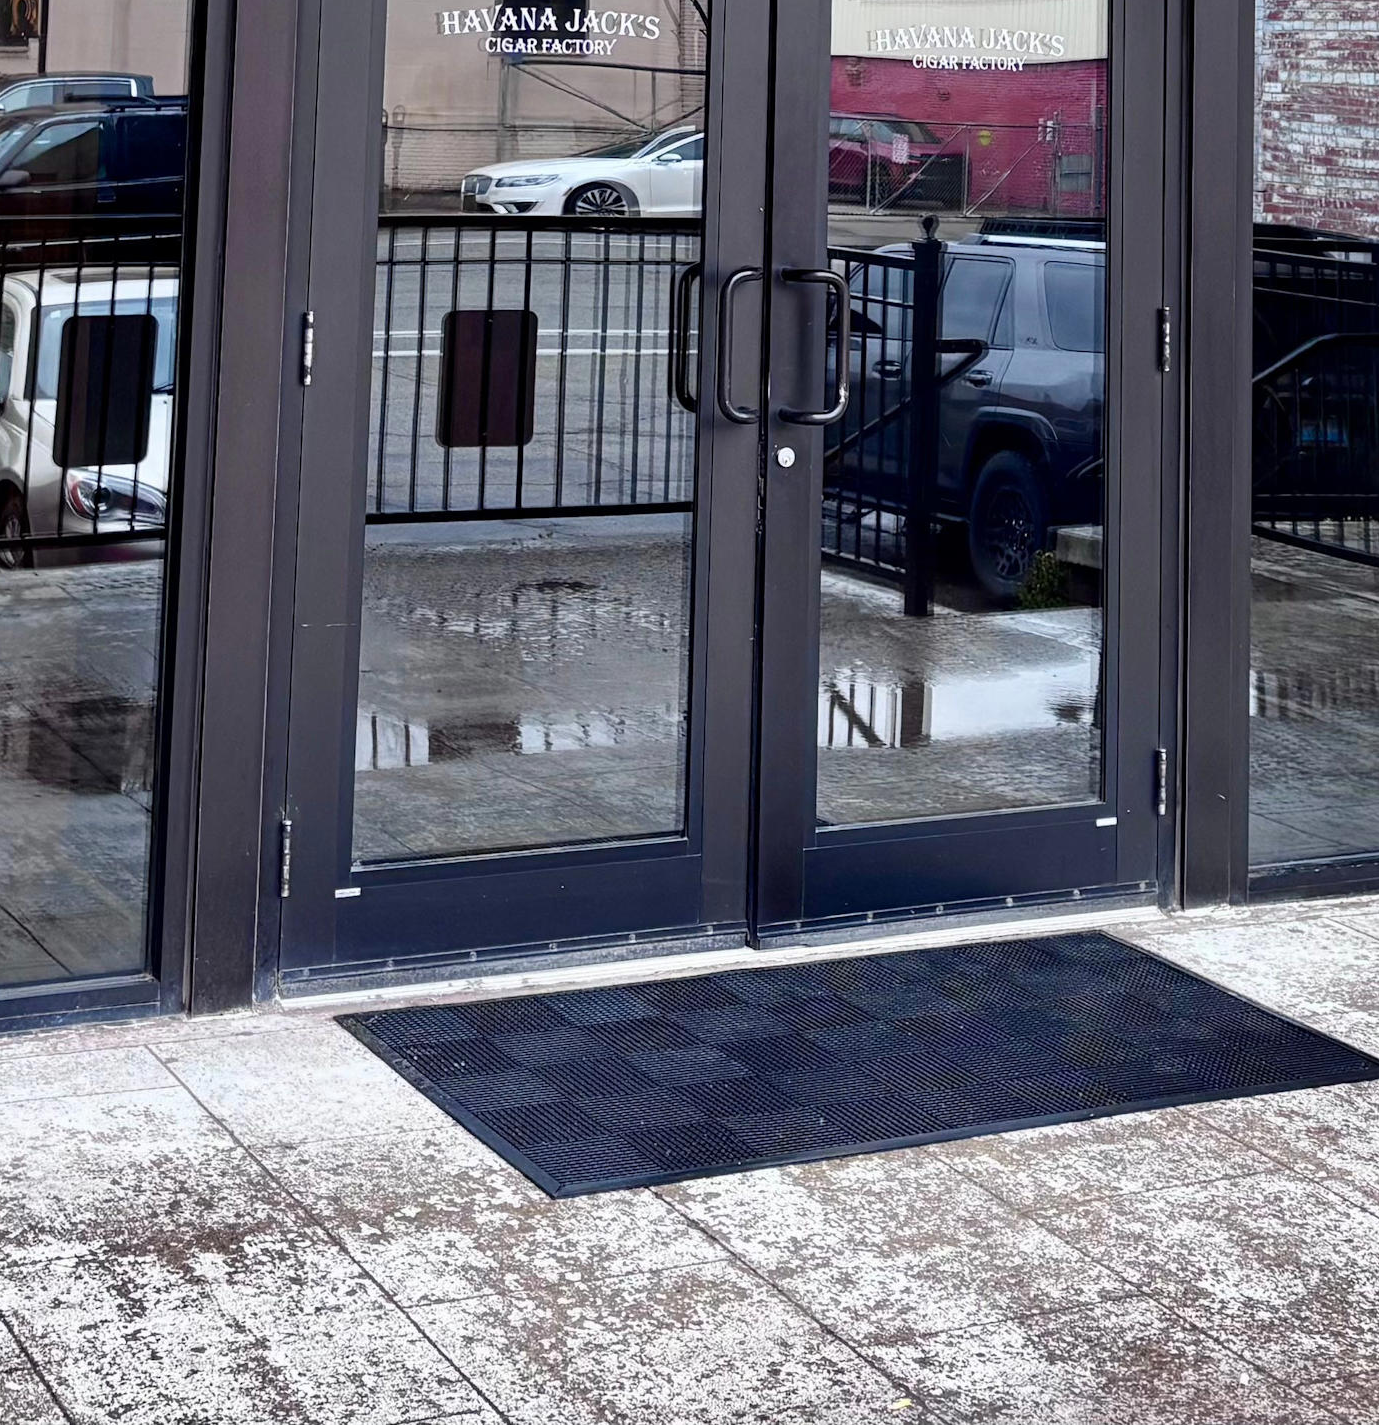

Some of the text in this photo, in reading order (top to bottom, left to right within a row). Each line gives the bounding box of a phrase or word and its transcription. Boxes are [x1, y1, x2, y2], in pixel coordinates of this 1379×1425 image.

[442, 4, 660, 40] HAVANA JACK'S
[485, 37, 617, 55] CIGAR FACTORY
[875, 23, 1065, 57] HAVANA JACK'S
[912, 54, 1027, 72] CIGAR FACTORY
